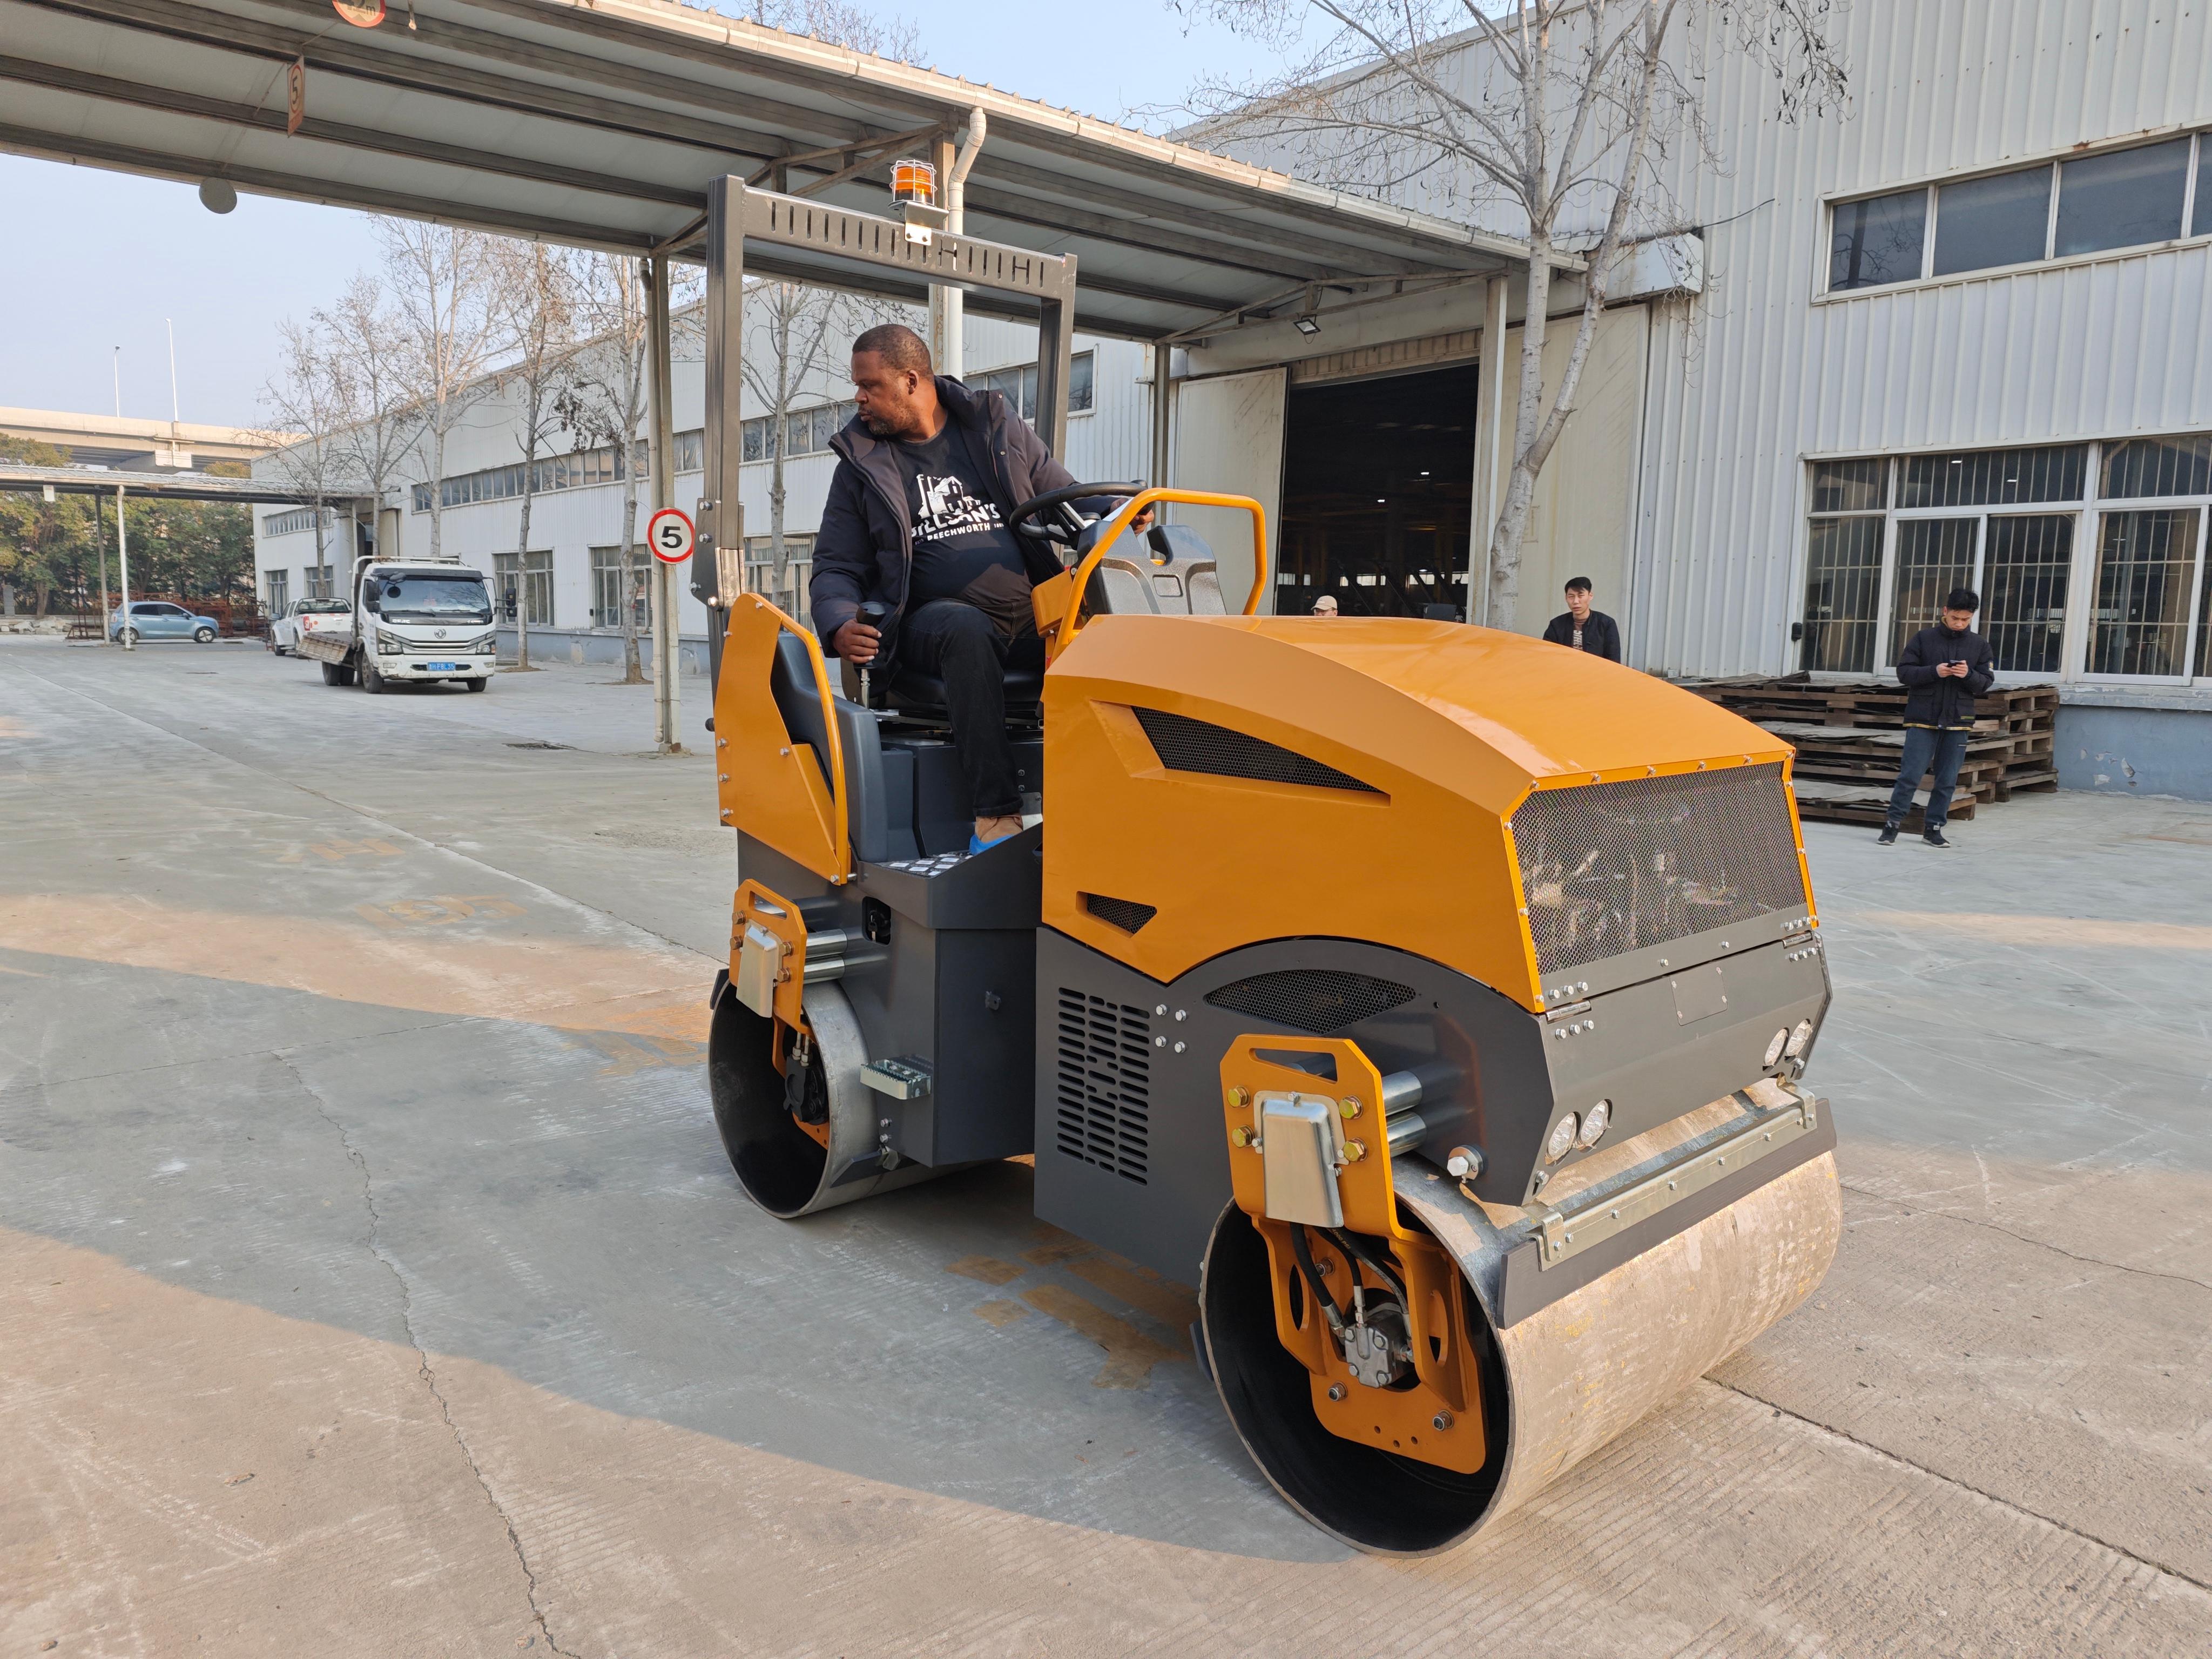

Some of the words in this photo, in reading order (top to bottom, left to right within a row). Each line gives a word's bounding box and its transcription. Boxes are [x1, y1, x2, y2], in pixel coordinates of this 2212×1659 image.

[292, 75, 298, 105] 5
[661, 525, 683, 549] 5
[927, 523, 990, 541] BEECHWORTH
